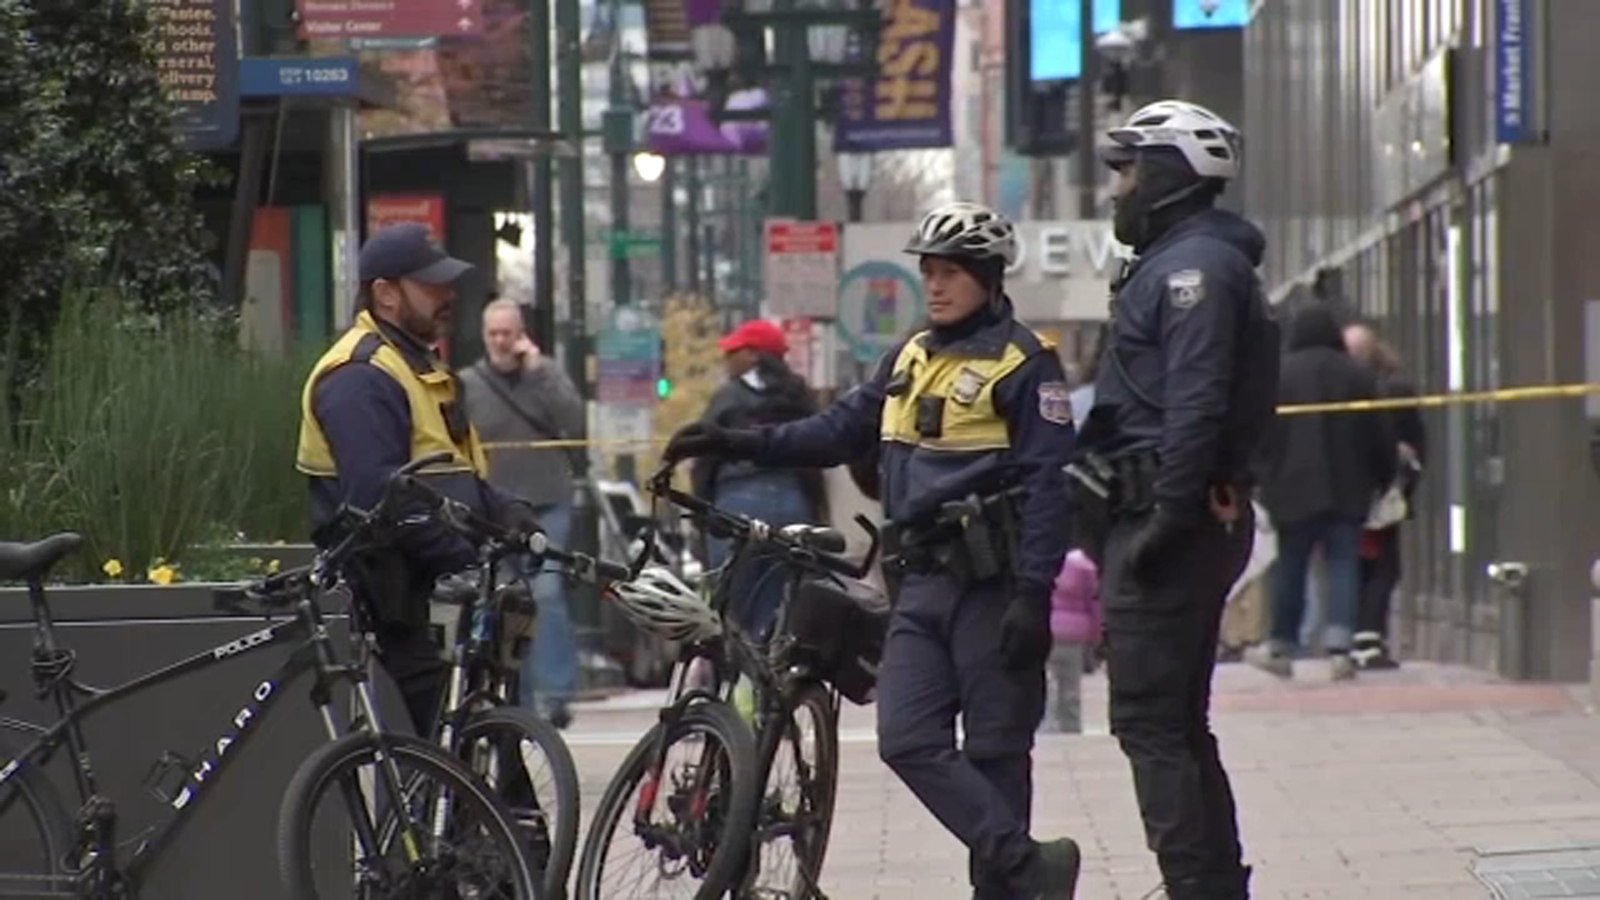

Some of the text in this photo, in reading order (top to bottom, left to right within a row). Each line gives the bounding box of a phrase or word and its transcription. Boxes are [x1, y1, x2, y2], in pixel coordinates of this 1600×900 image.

[306, 19, 381, 33] Visitor Center
[1501, 0, 1520, 42] Fran
[172, 38, 216, 52] other
[876, 0, 941, 120] ASH
[159, 54, 215, 70] eneral,
[1502, 47, 1520, 108] Market
[214, 628, 273, 659] POLICE
